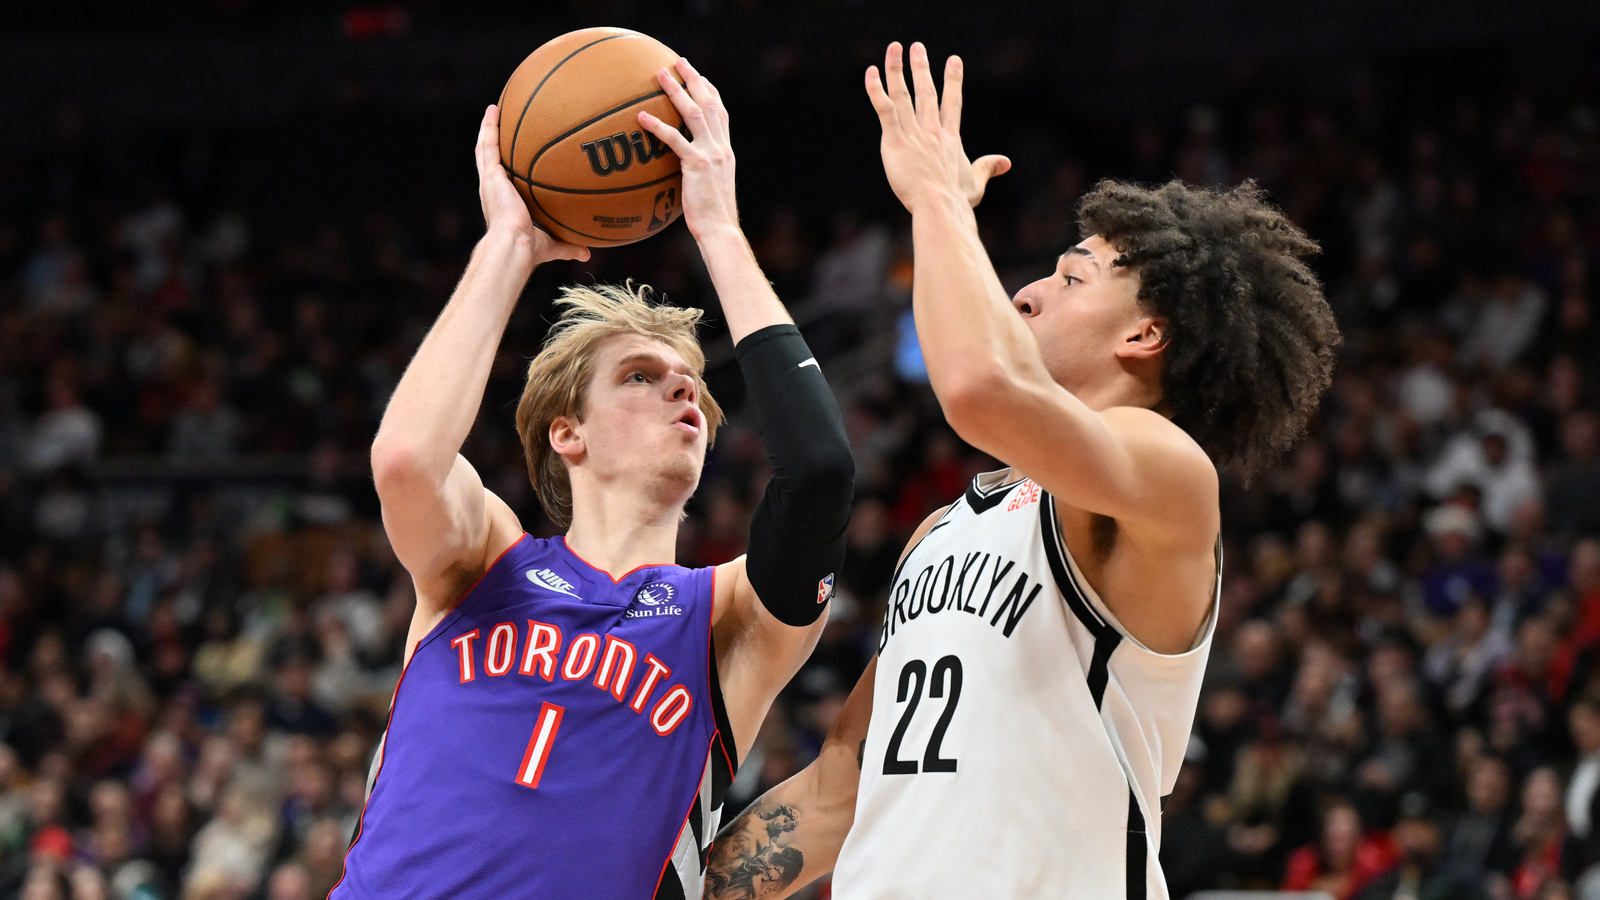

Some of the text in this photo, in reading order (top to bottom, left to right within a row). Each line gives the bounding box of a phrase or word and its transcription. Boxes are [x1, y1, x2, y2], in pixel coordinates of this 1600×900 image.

[581, 125, 691, 177] Wil
[537, 568, 575, 592] NIKE
[626, 605, 682, 618] Sun Life
[451, 619, 693, 736] TORONTO
[514, 701, 566, 789] 1
[882, 655, 963, 775] 22
